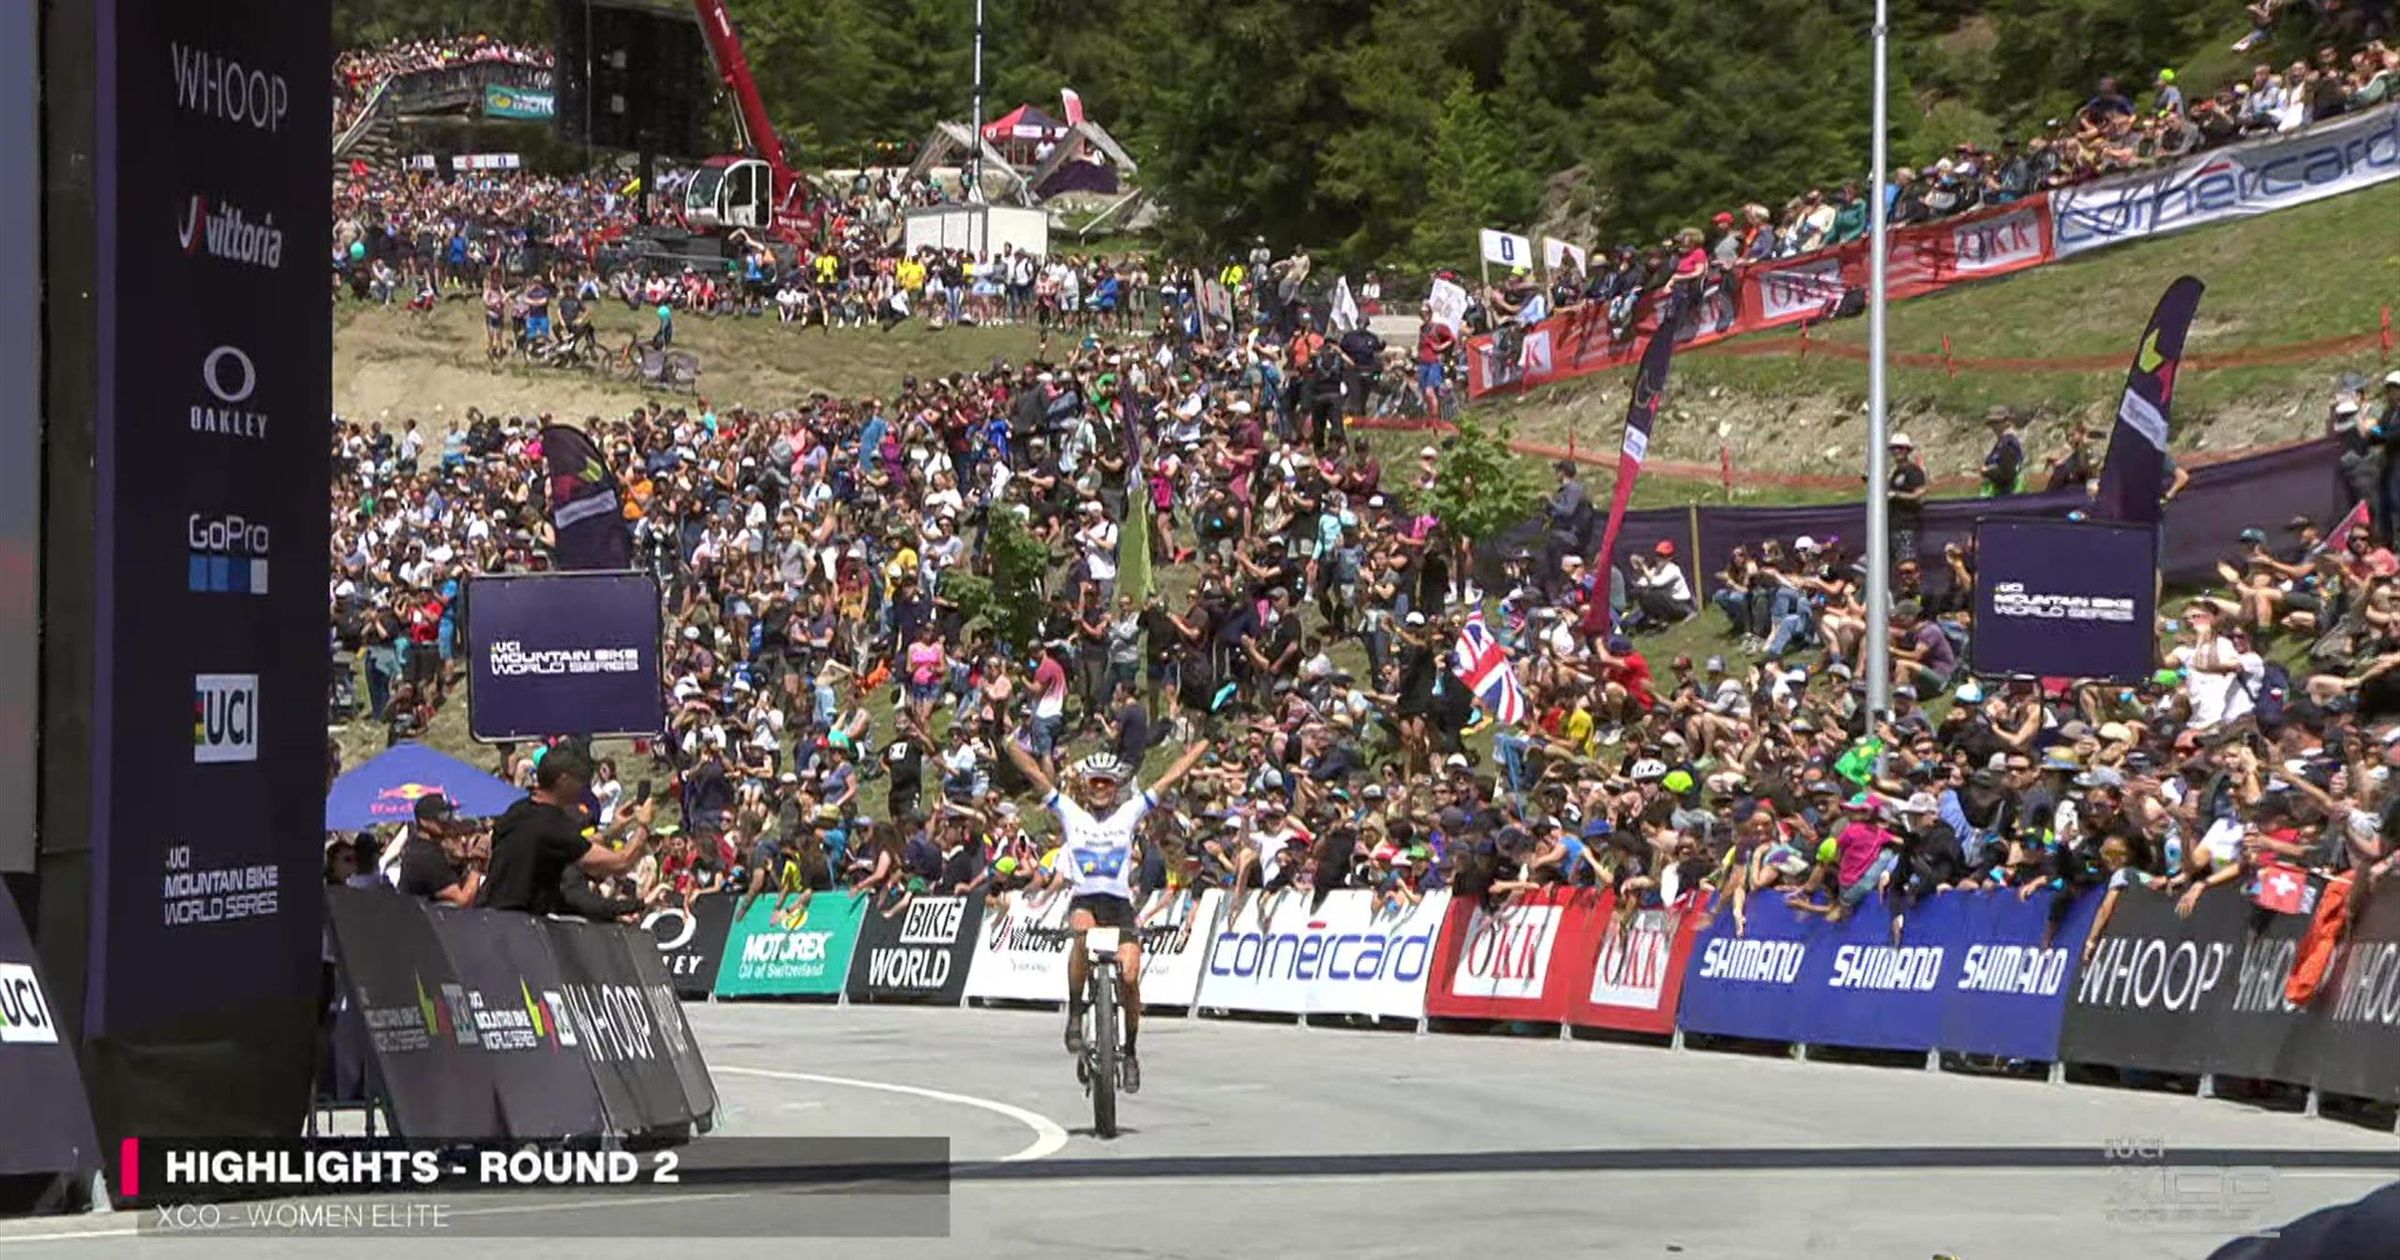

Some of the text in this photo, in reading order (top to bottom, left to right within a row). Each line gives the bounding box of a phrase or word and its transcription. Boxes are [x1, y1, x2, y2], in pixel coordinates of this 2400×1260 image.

[170, 41, 288, 133] WHOOP
[206, 200, 283, 269] vittoria
[190, 406, 268, 439] OAKLEY
[189, 513, 269, 553] GoPro
[490, 649, 639, 664] MOUNTAIN BIKE
[496, 641, 521, 652] UCI
[491, 661, 566, 676] WORLD
[206, 690, 253, 746] UCI
[169, 846, 190, 869] UCI
[164, 865, 279, 899] MOUNTAIN BIKE
[164, 890, 278, 926] WORLD SERIES
[905, 903, 961, 938] BIKE
[767, 963, 824, 978] Switzerland
[868, 948, 951, 988] WORLD
[1700, 938, 1805, 984] SHIMANO
[1829, 945, 1944, 991] SHIMANO
[1958, 944, 2068, 995] SHIMANO
[0, 978, 48, 1029] UCI
[562, 983, 655, 1062] WHOOP
